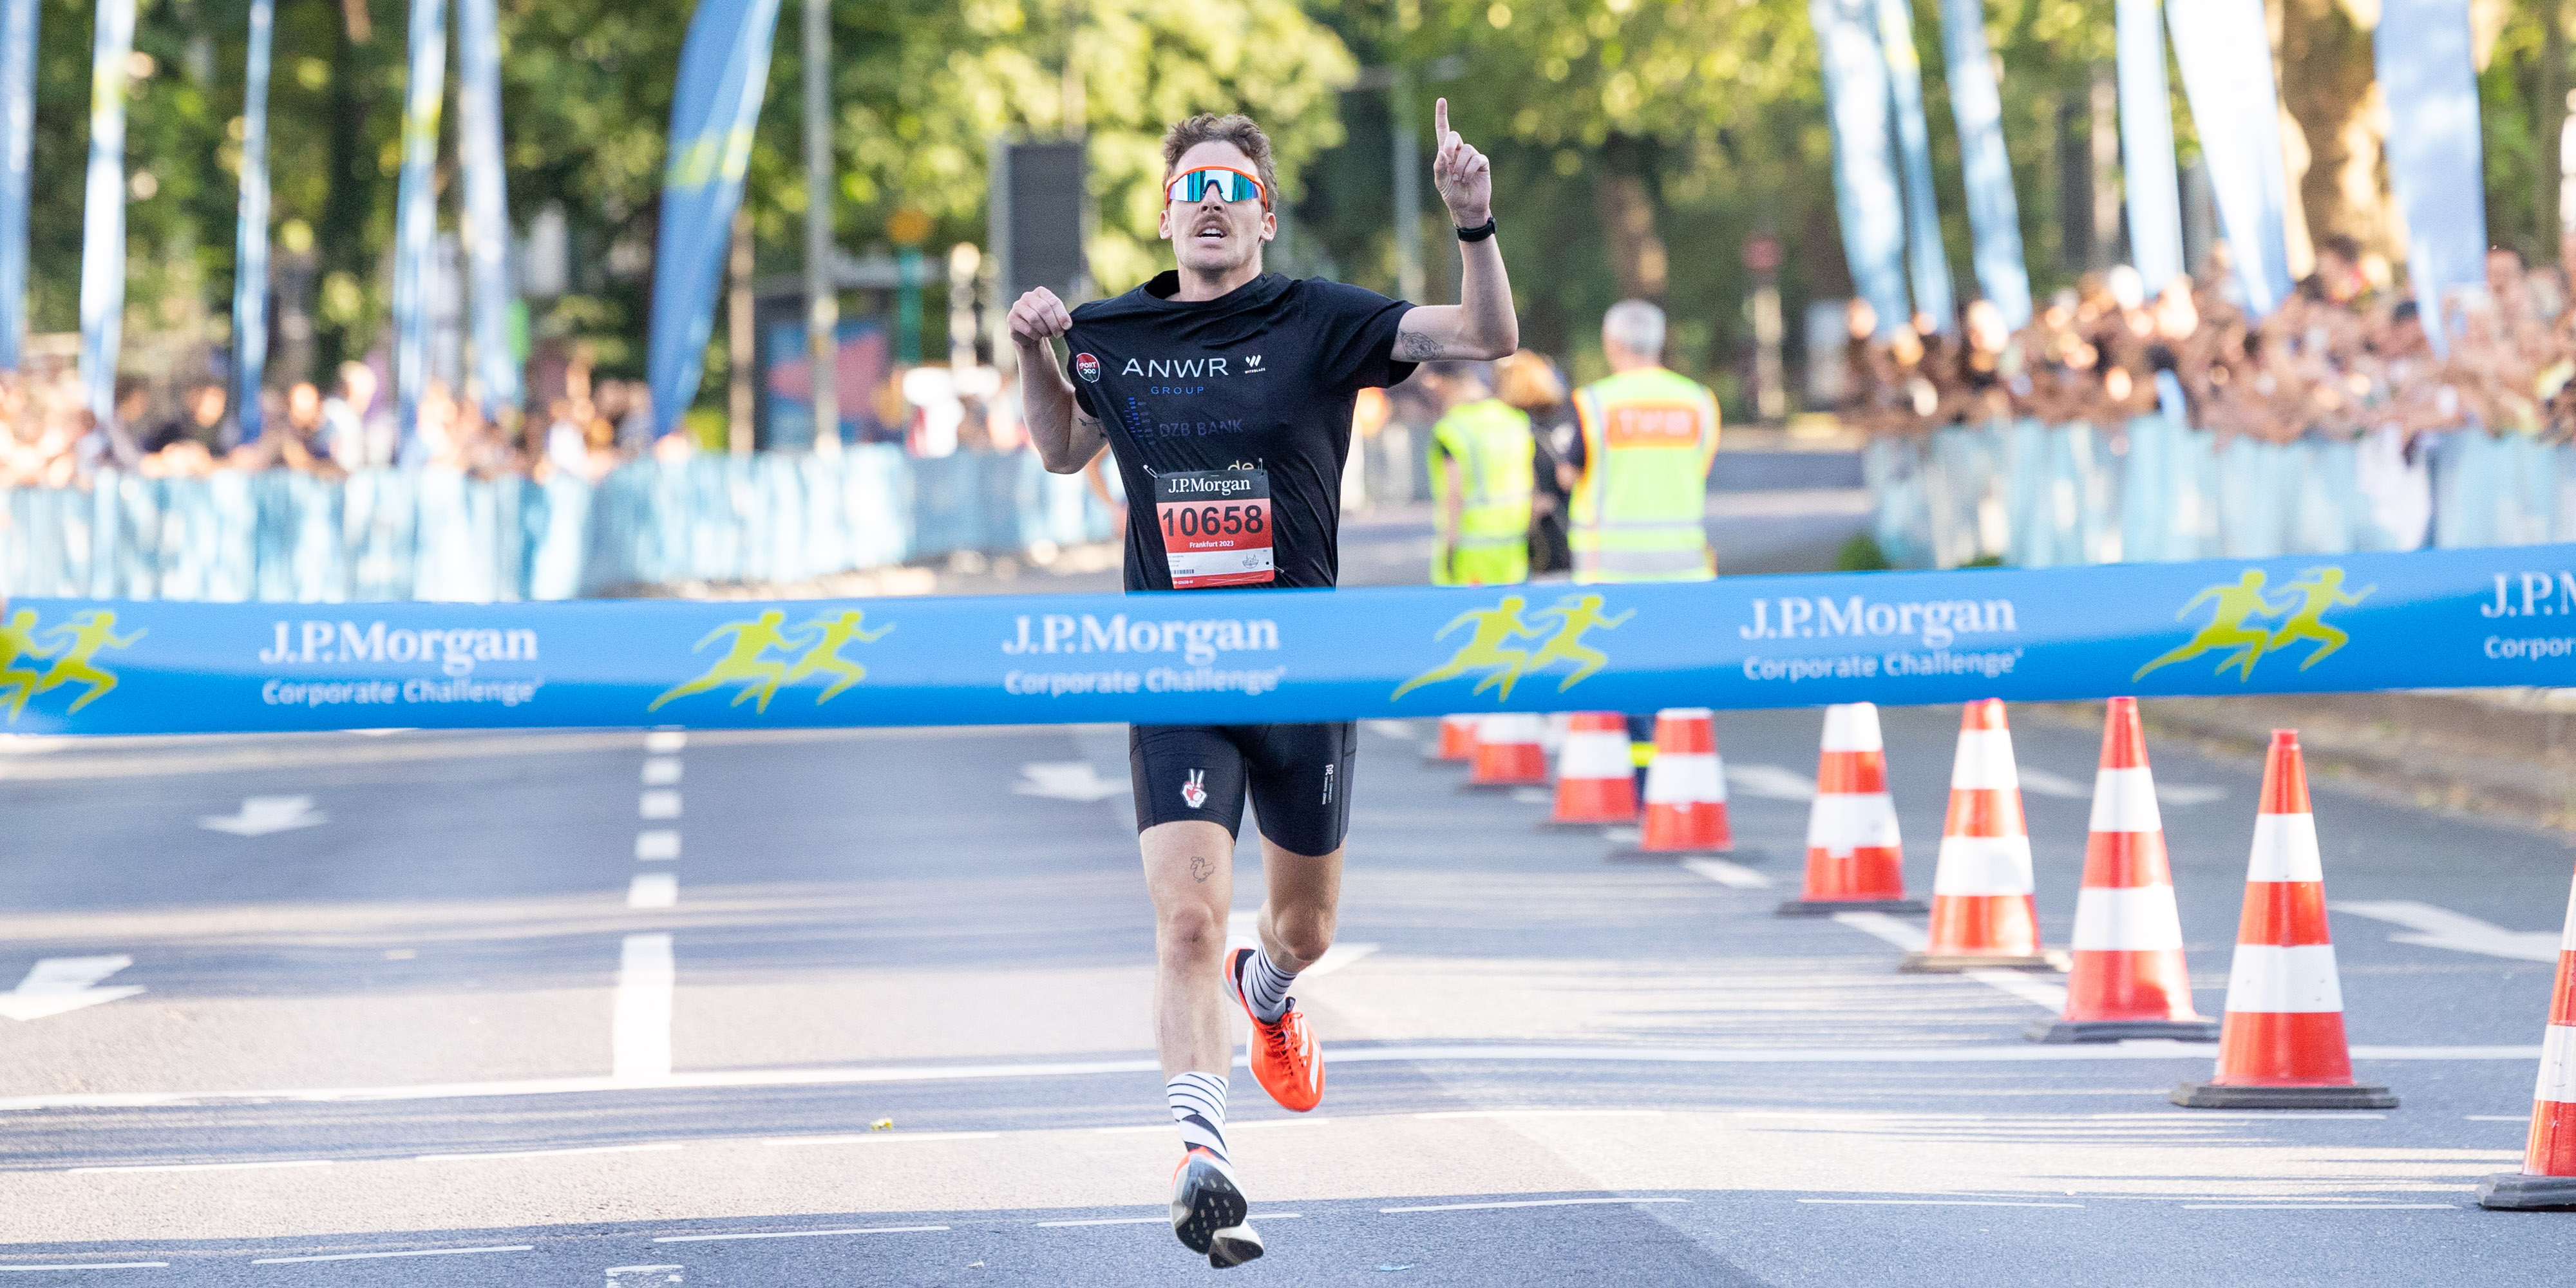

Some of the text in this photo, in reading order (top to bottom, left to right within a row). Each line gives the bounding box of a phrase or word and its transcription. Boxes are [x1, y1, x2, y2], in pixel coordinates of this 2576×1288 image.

[1122, 358, 1229, 378] ANWR
[1159, 419, 1243, 437] DZB BANK
[1168, 478, 1251, 495] J.P.Morgan
[1162, 505, 1264, 536] 10658
[1740, 595, 2016, 649] J.P.Morgan
[259, 620, 538, 676] J.P.Morgan
[1001, 613, 1279, 666] J.P.Morgan
[1005, 670, 1141, 697] Corporate
[1743, 656, 1879, 683] Corporate
[262, 679, 399, 708] Corporate
